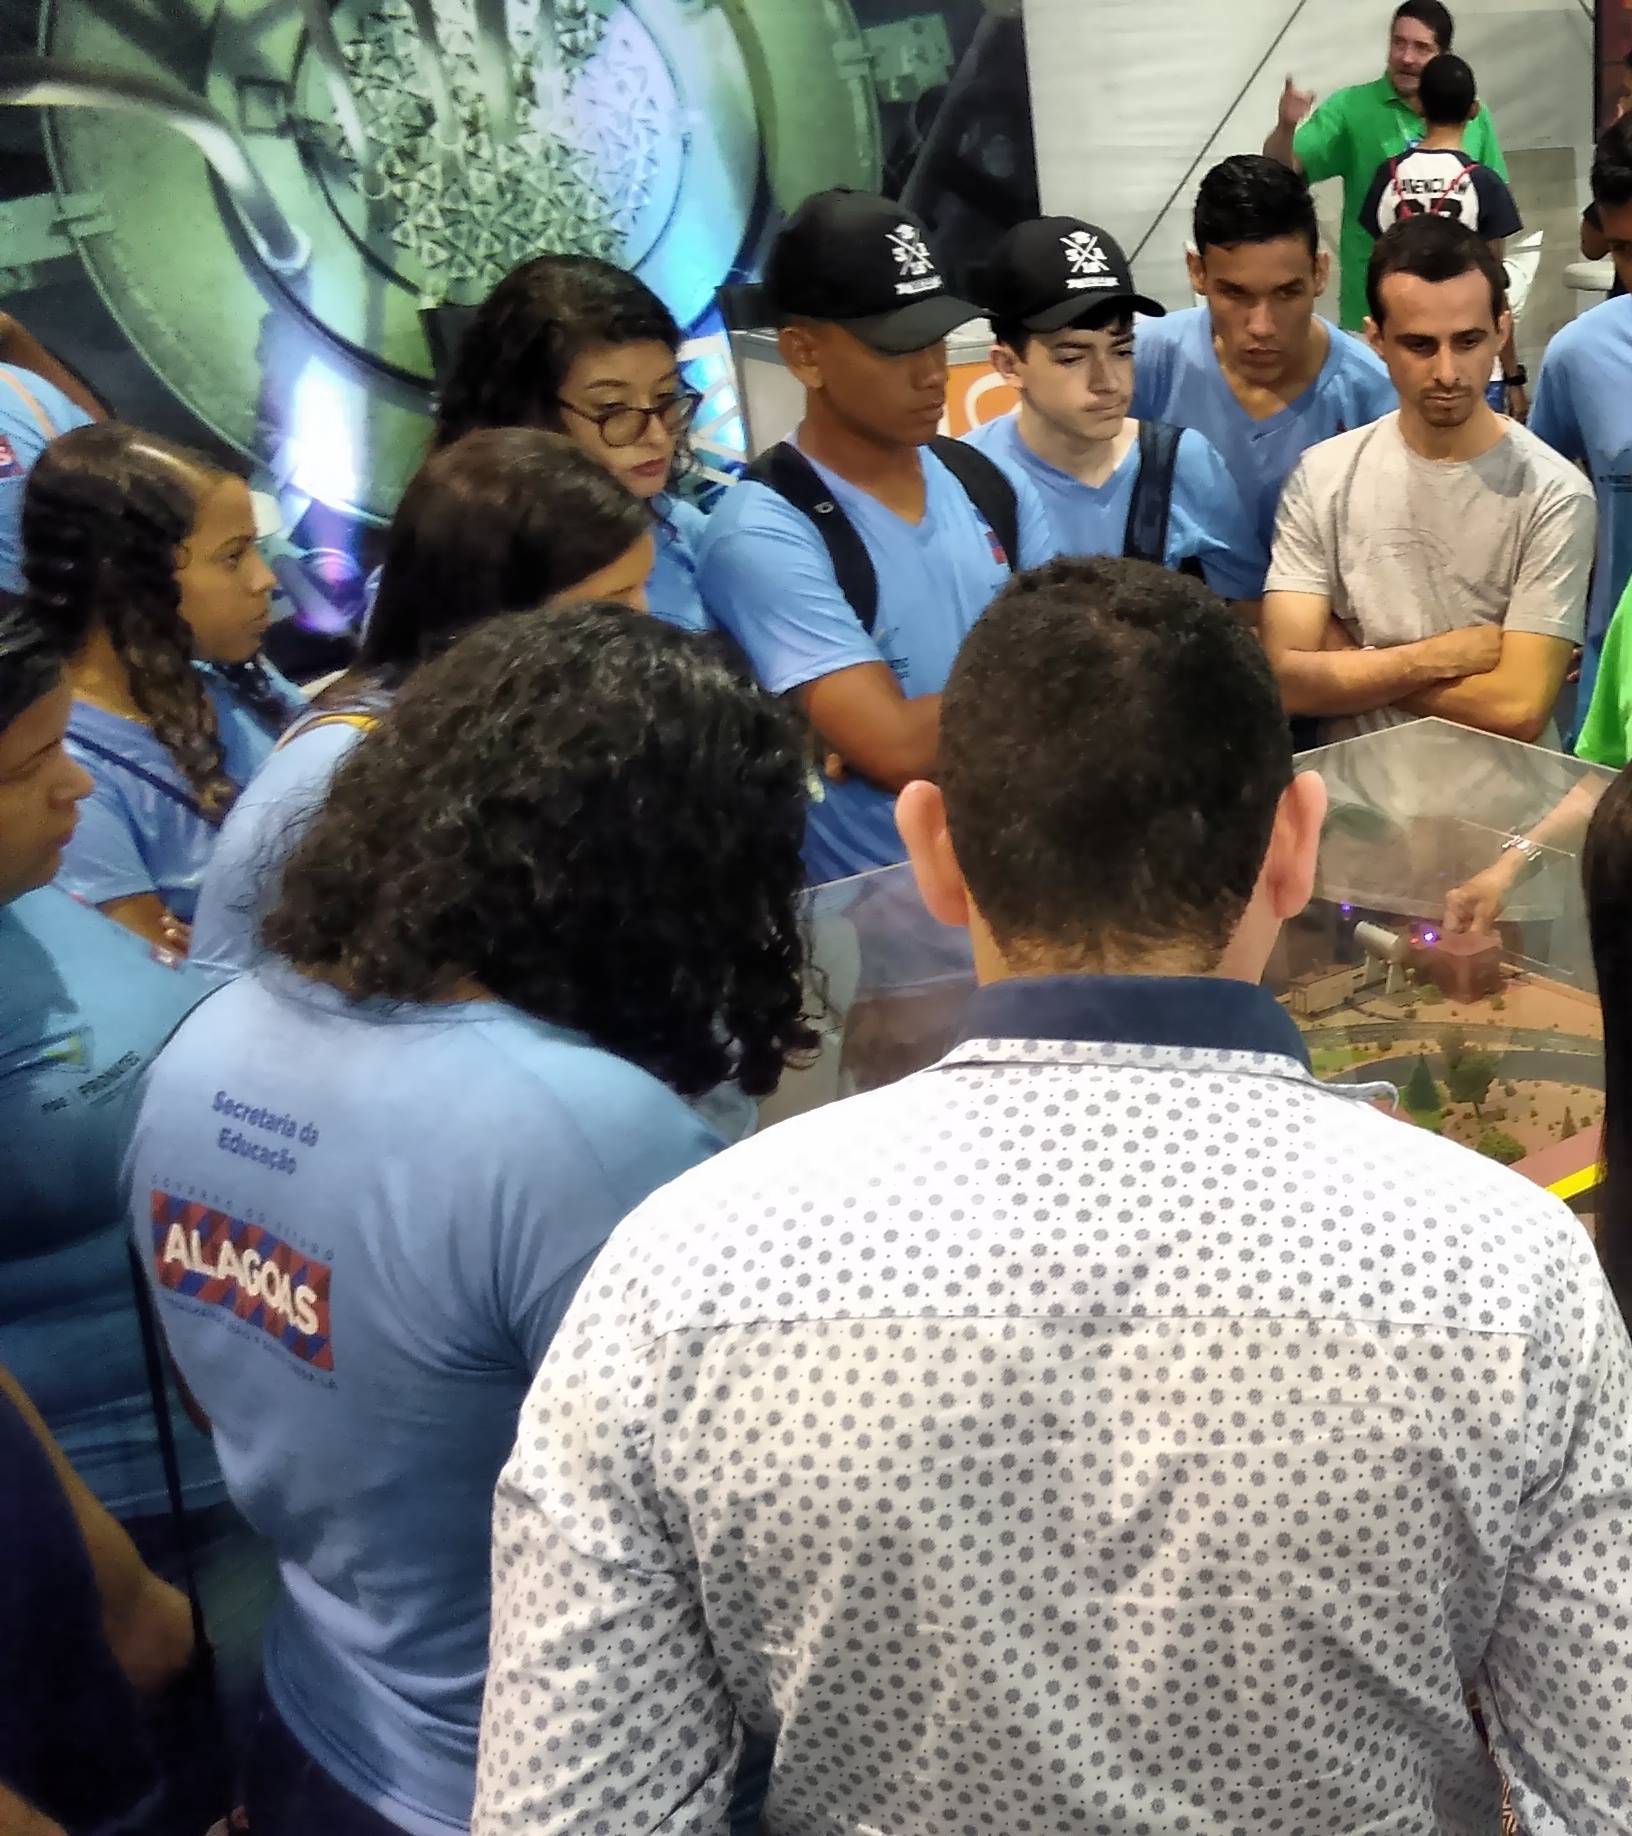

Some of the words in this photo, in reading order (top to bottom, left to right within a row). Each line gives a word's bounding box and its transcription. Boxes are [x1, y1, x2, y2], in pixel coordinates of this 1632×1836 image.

[212, 1090, 298, 1139] Secretaria
[299, 1121, 320, 1147] da
[217, 1126, 298, 1175] Educação
[163, 1222, 320, 1336] ALAGOAS
